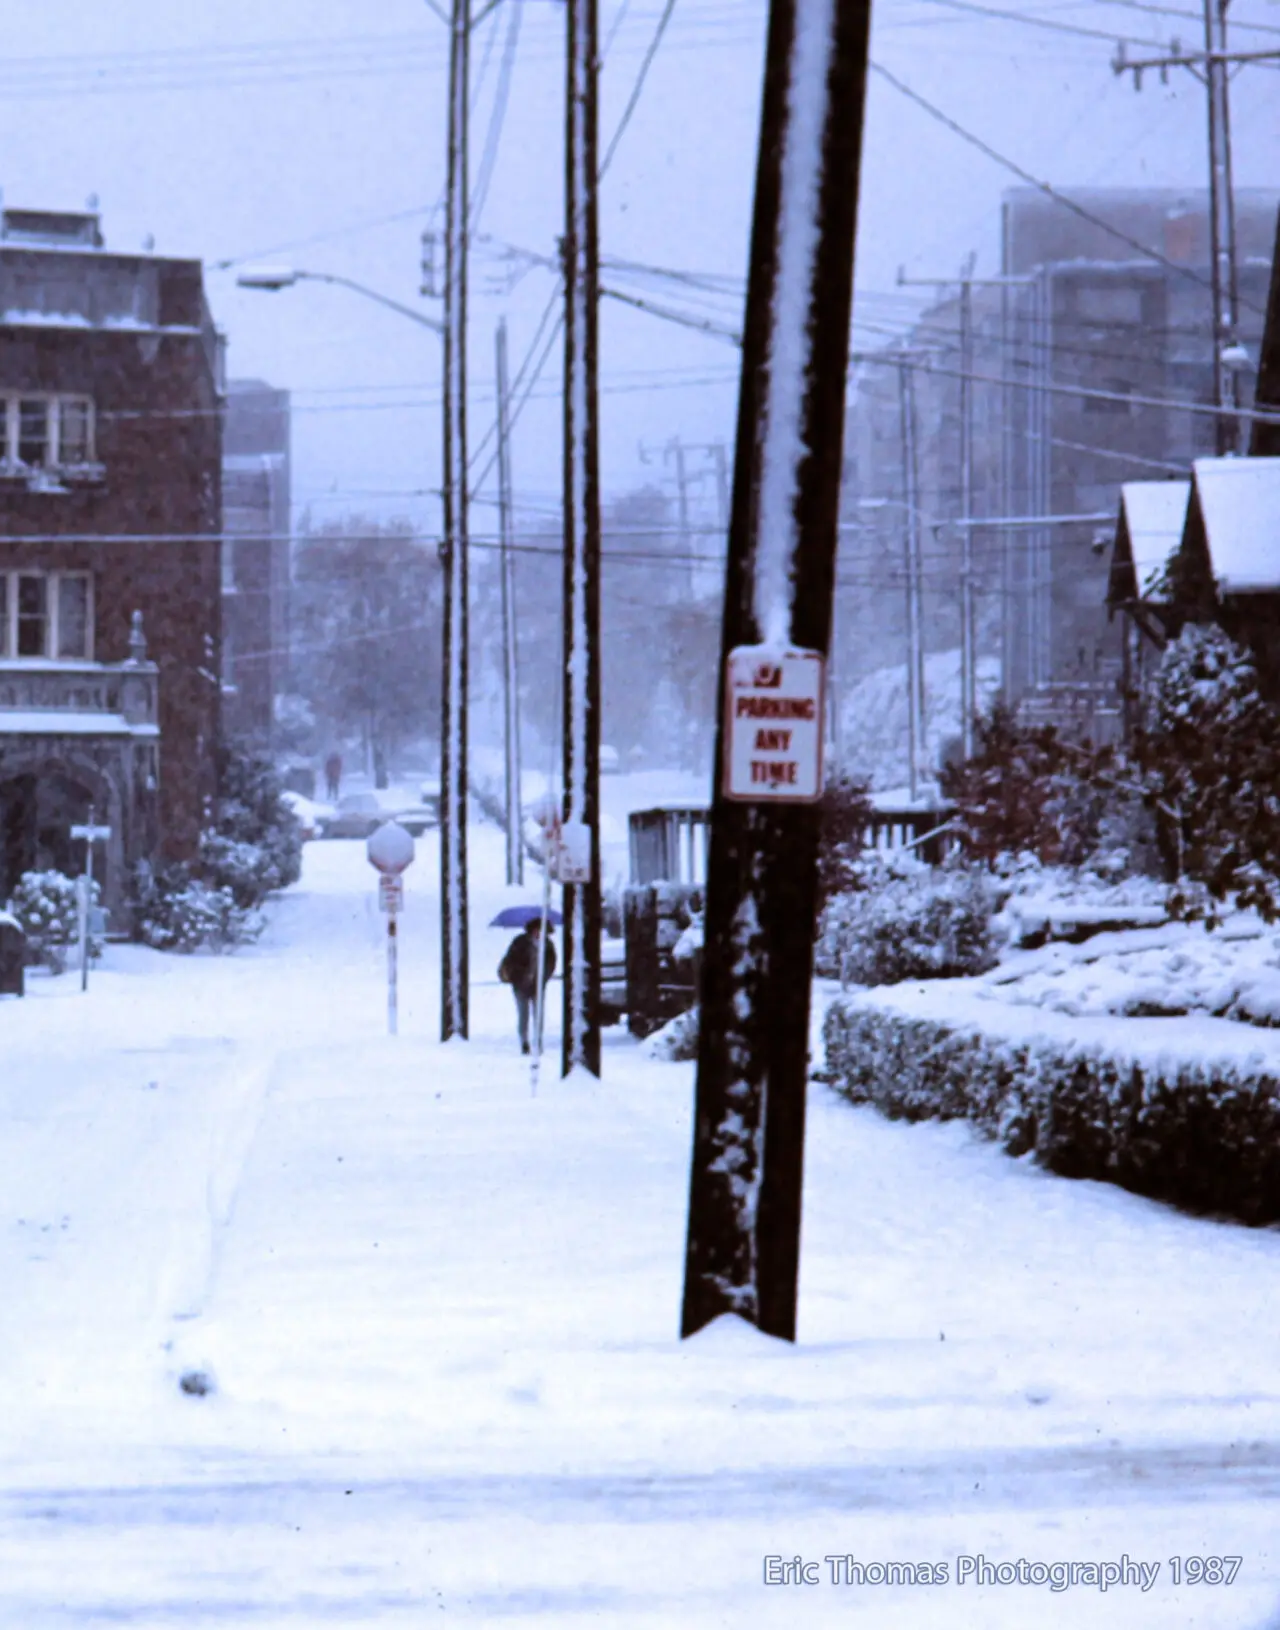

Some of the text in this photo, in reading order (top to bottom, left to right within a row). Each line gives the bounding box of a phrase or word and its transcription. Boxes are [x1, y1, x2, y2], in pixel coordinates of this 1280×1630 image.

[737, 698, 815, 720] PARKING
[755, 729, 792, 751] ANY
[750, 761, 798, 784] TIME
